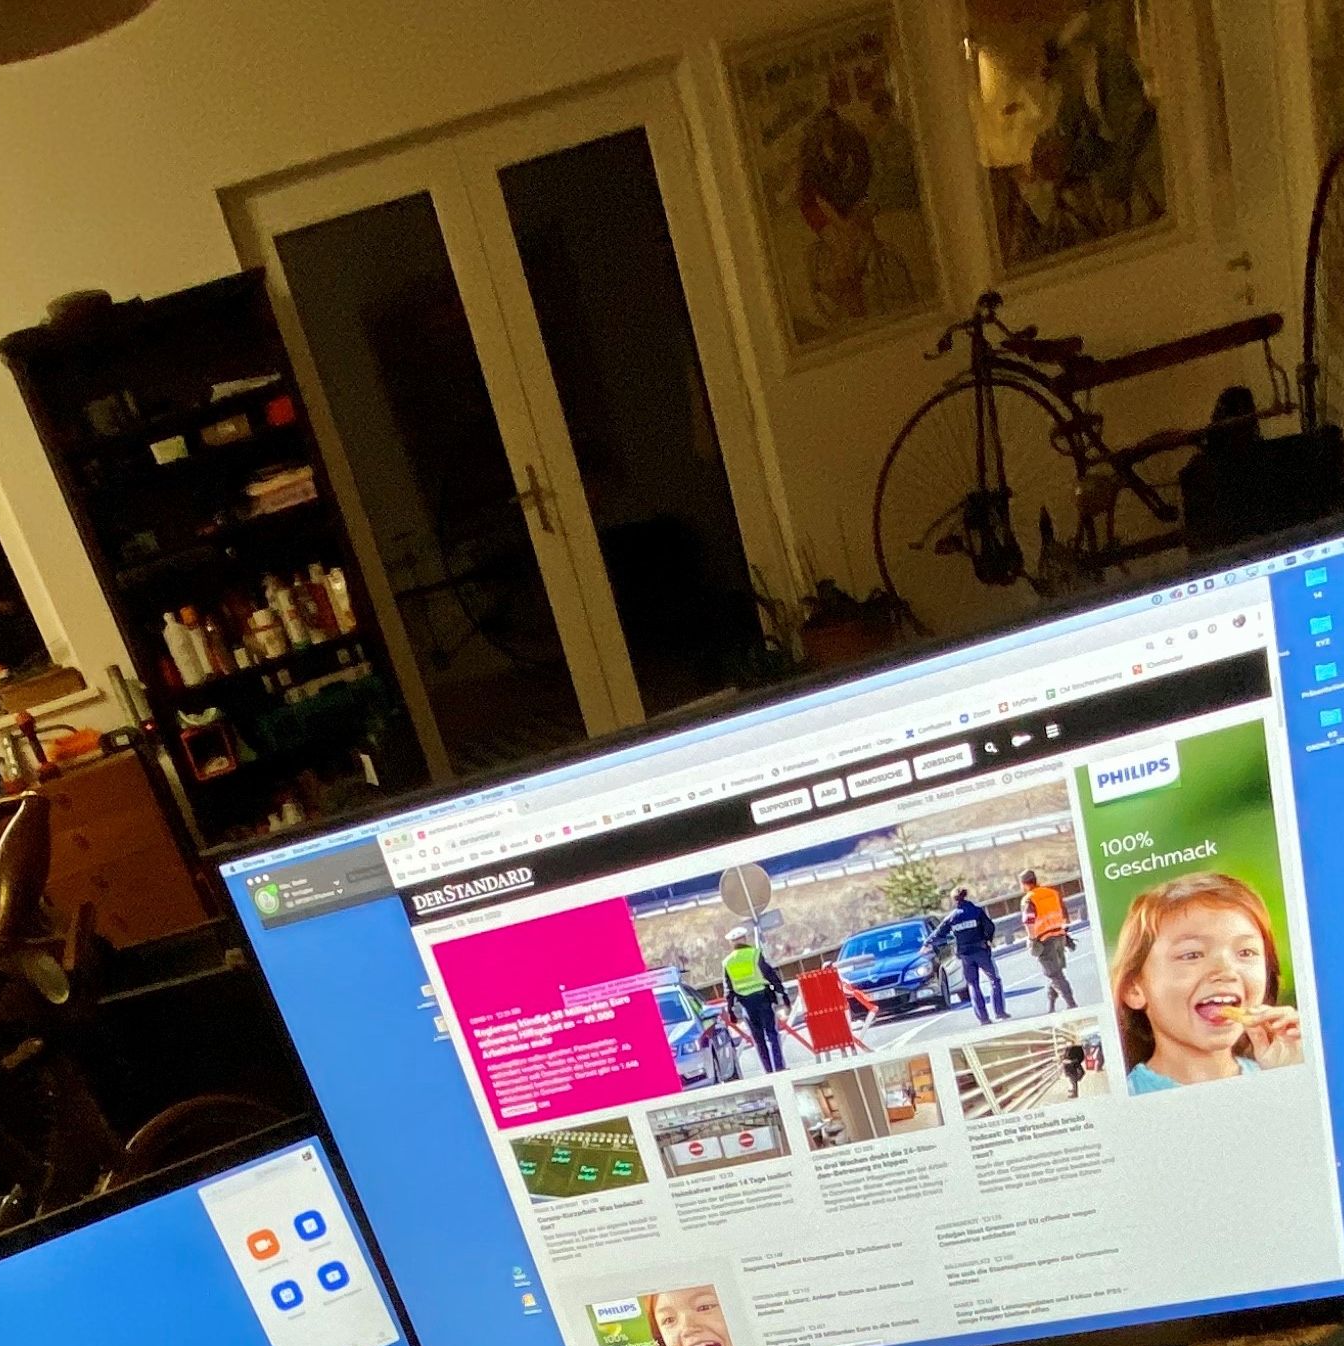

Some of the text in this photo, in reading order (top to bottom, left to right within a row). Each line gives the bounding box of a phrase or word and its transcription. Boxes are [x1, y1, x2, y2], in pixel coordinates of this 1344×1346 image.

[1096, 756, 1170, 788] PHILIPS
[1098, 829, 1154, 858] 100%
[1103, 837, 1218, 881] Geschmack
[412, 868, 531, 911] DERSTANDARD
[596, 1302, 637, 1317] PHILIPS
[602, 1332, 629, 1344] 100%
